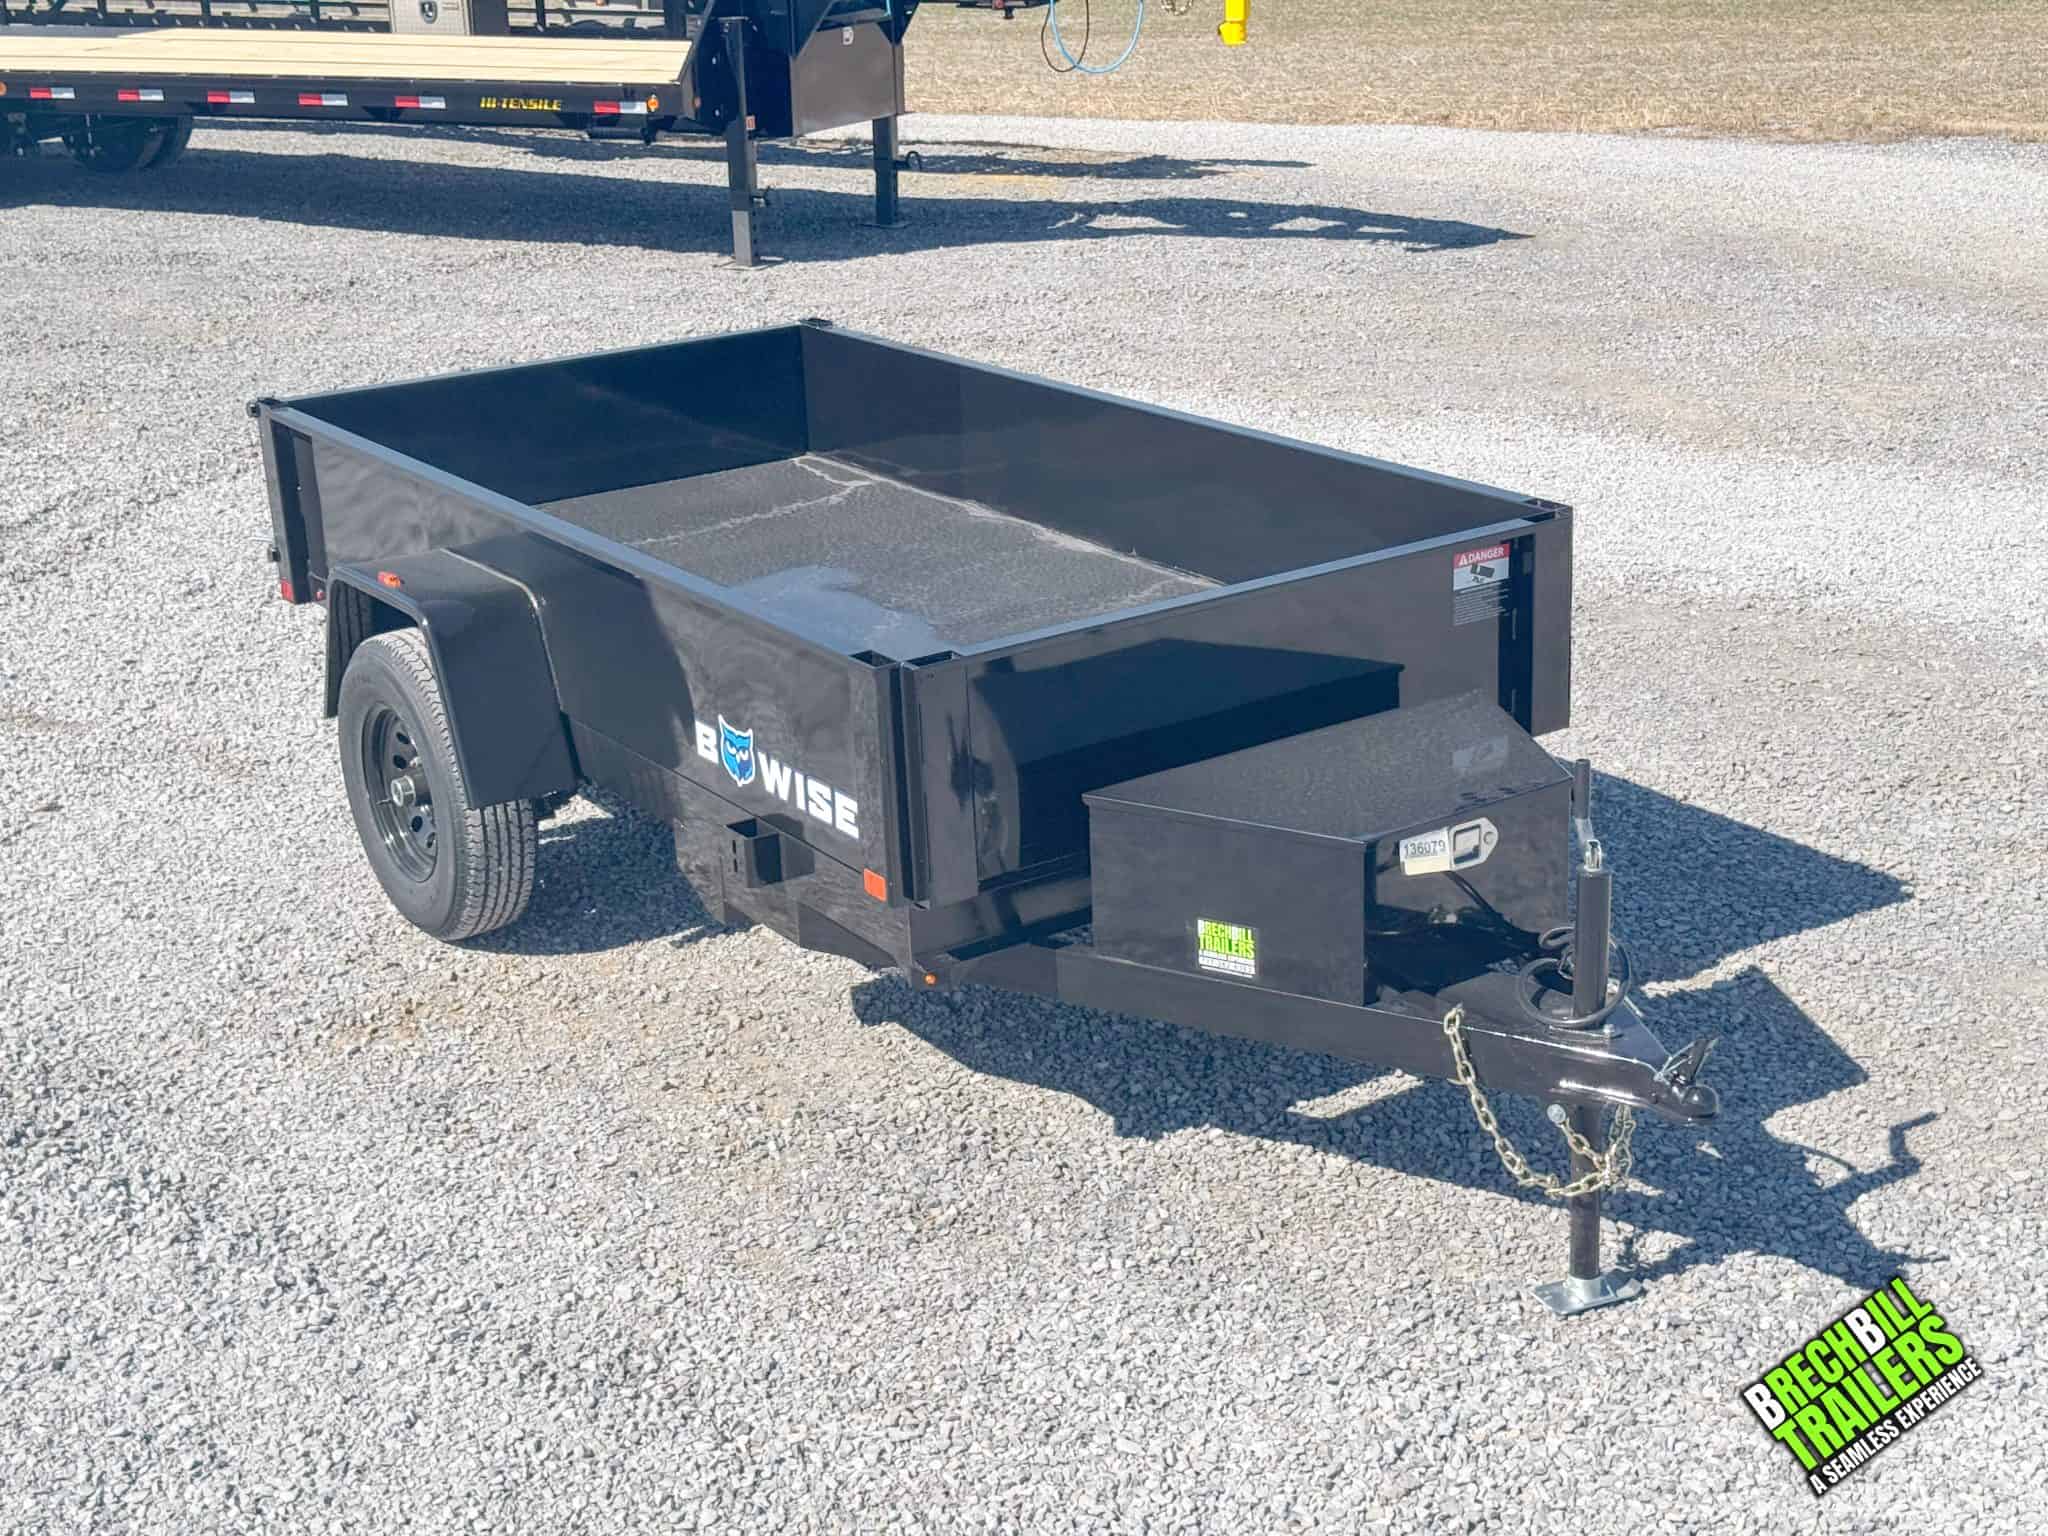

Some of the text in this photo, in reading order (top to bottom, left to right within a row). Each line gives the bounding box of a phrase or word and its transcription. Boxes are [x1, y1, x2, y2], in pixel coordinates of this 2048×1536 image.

[480, 97, 561, 111] HI-TENSILE
[1469, 547, 1504, 563] DANGER
[1404, 840, 1446, 857] 136079
[1199, 935, 1255, 959] TRAILERS
